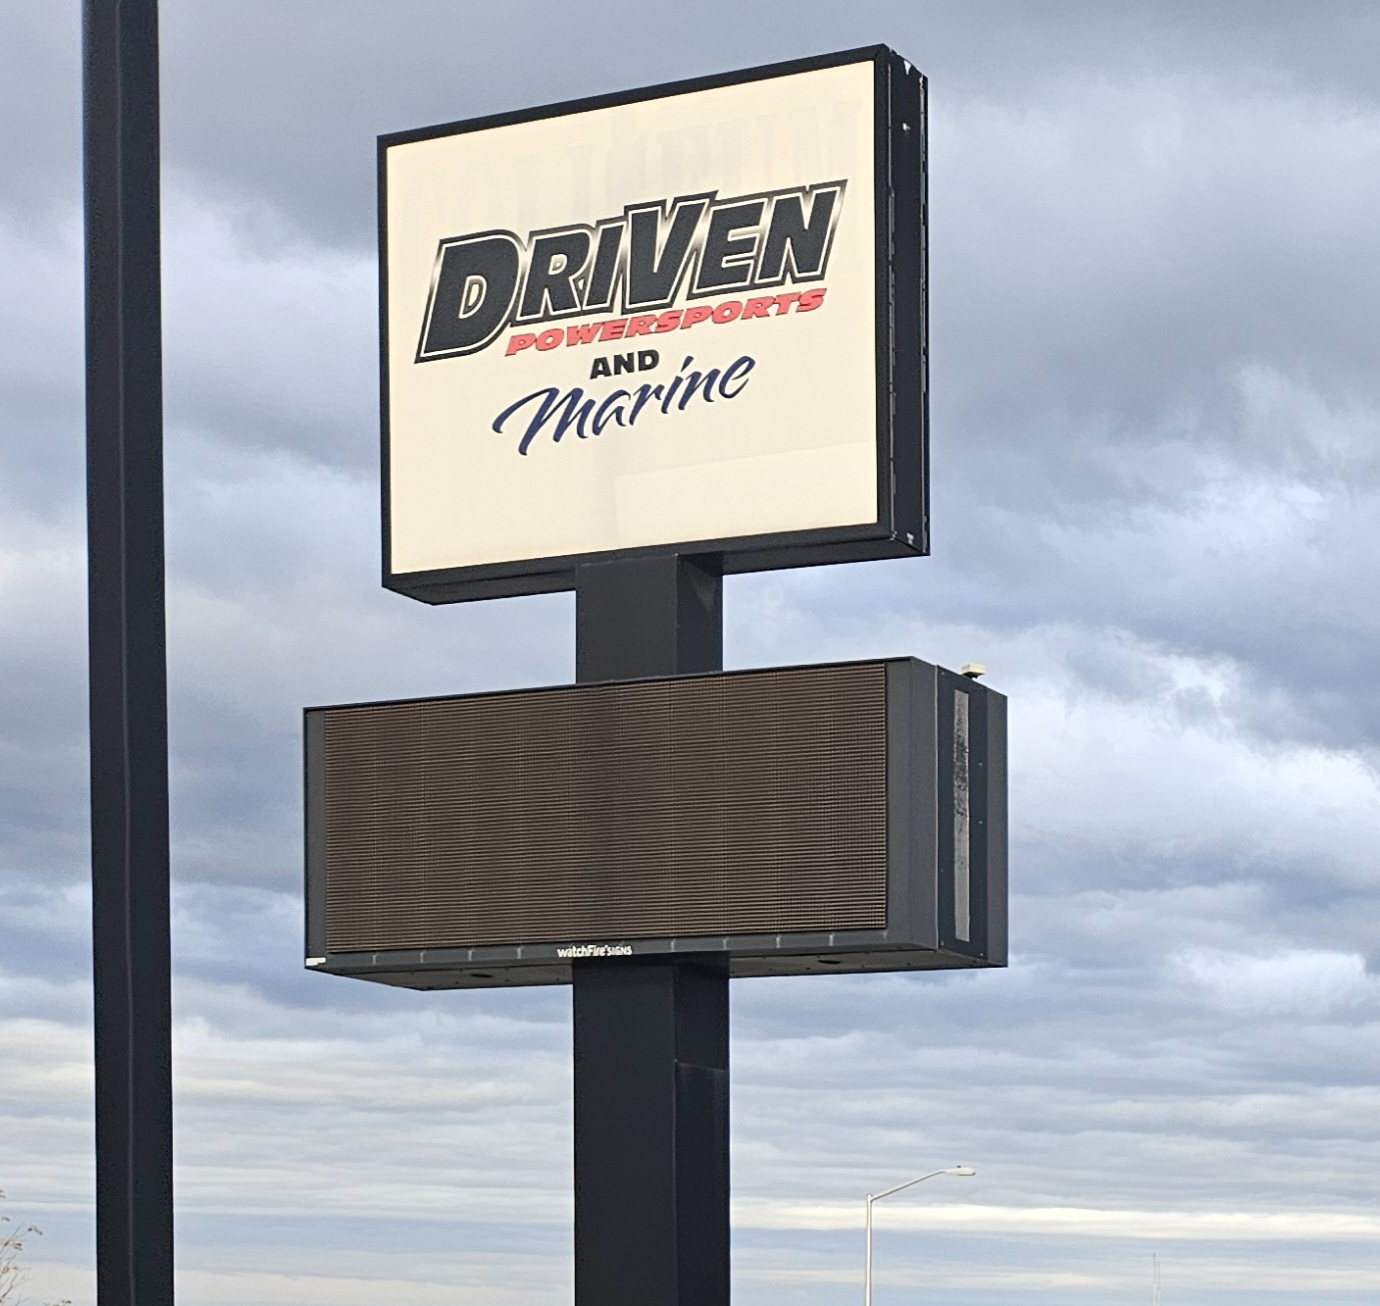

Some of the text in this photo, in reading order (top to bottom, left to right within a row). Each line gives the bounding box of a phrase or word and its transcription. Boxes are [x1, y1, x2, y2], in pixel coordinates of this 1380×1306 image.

[415, 179, 849, 364] DRIVEN
[504, 287, 828, 357] POWERSPORTS
[590, 348, 660, 379] AND
[491, 355, 756, 456] Marine
